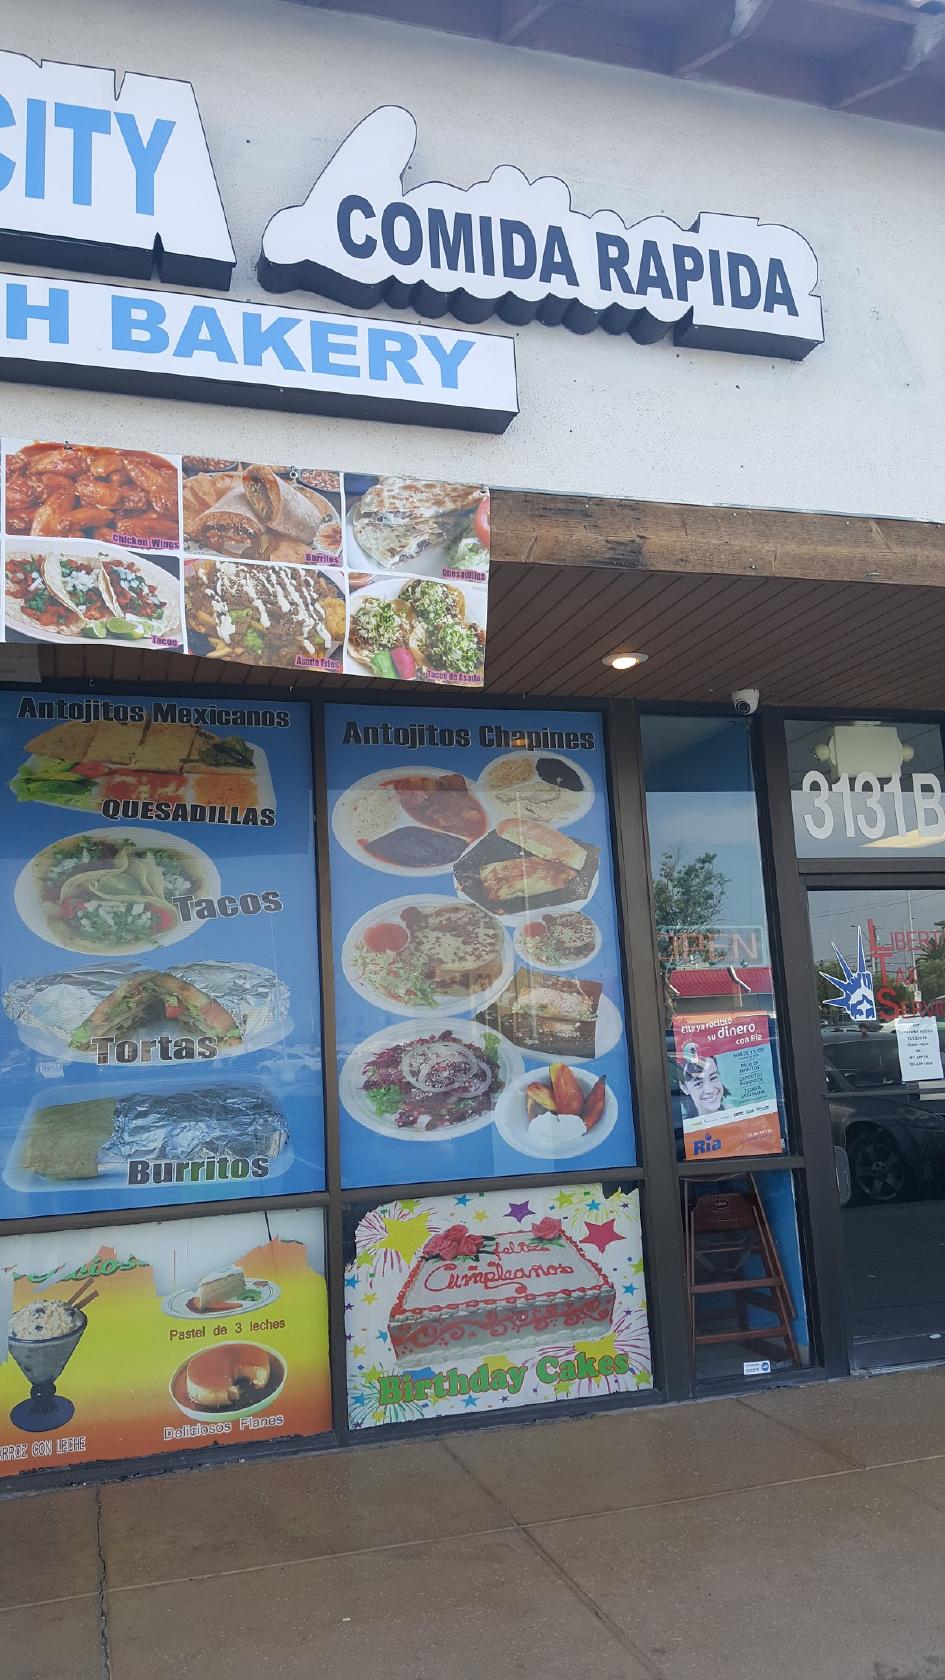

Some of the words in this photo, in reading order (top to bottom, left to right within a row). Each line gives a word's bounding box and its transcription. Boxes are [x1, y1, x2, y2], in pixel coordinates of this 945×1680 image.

[336, 194, 580, 288] COMIDA
[595, 231, 800, 318] RAPIDA
[111, 294, 476, 390] BAKERY
[112, 533, 149, 547] Chicken
[151, 538, 180, 550] Wings
[305, 553, 339, 564] Burritos
[151, 634, 179, 647] Tacos
[320, 658, 340, 670] Fries
[428, 670, 448, 680] Tacos
[458, 673, 481, 682] Asada
[17, 696, 146, 724] Antojitos
[152, 702, 290, 728] Mexicanos
[342, 720, 472, 750] Antojitos
[479, 724, 596, 752] Chapines
[101, 799, 277, 828] QUESADILLAS
[802, 770, 945, 840] 3131B
[171, 890, 284, 922] Tacos
[717, 1023, 756, 1039] dinero
[735, 1036, 750, 1045] con
[91, 1035, 219, 1065] Tortas
[692, 1133, 722, 1156] Ria
[127, 1156, 270, 1186] Burritos
[169, 1326, 206, 1341] Pastel
[213, 1325, 228, 1336] de
[235, 1322, 243, 1334] 3
[250, 1319, 286, 1332] leches
[377, 1363, 528, 1406] Birthday
[535, 1351, 630, 1385] Cakes
[163, 1422, 232, 1440] Deliciosos
[239, 1414, 285, 1430] Flanes
[31, 1440, 52, 1457] CON
[56, 1435, 87, 1455] LECHE
